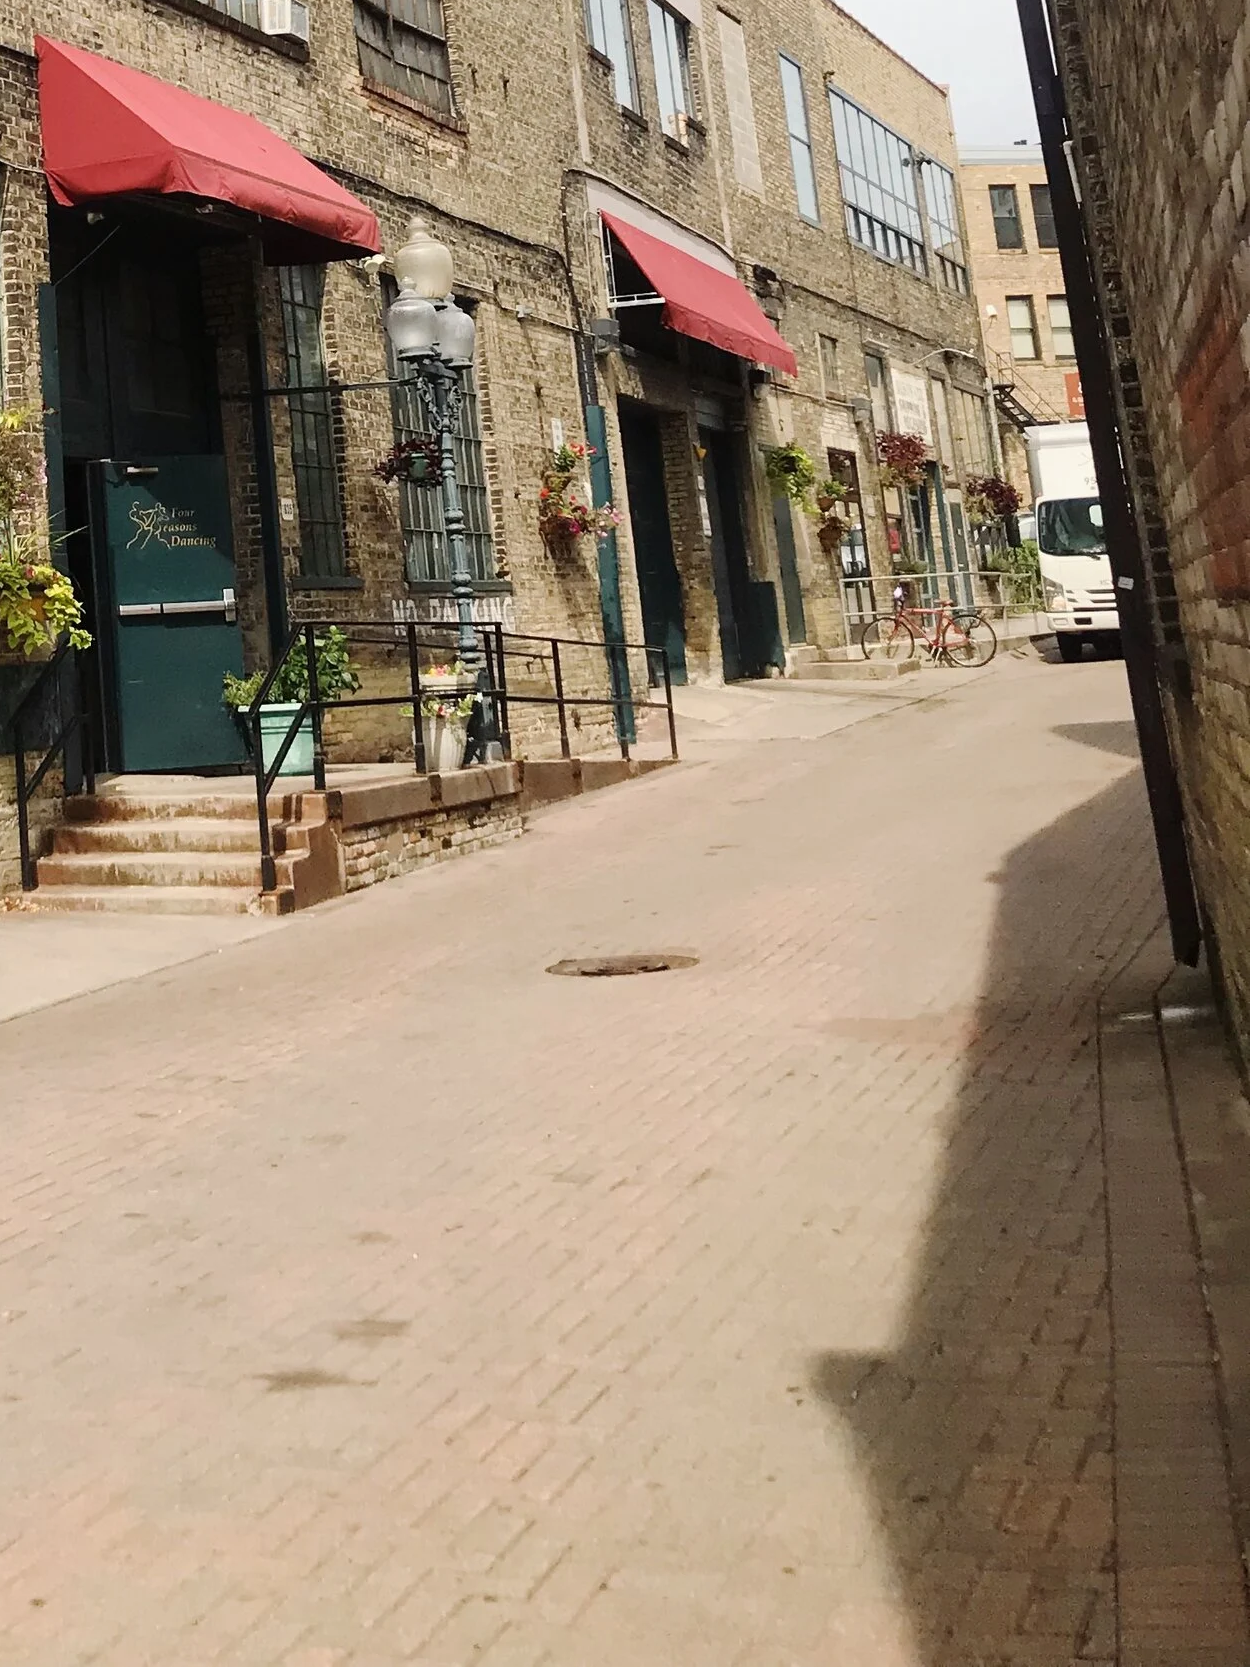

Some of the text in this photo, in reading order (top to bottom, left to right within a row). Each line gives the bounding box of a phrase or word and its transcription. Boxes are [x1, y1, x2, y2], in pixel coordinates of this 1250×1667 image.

[170, 507, 196, 518] Four
[171, 535, 217, 548] Dancing
[391, 599, 418, 636] NO
